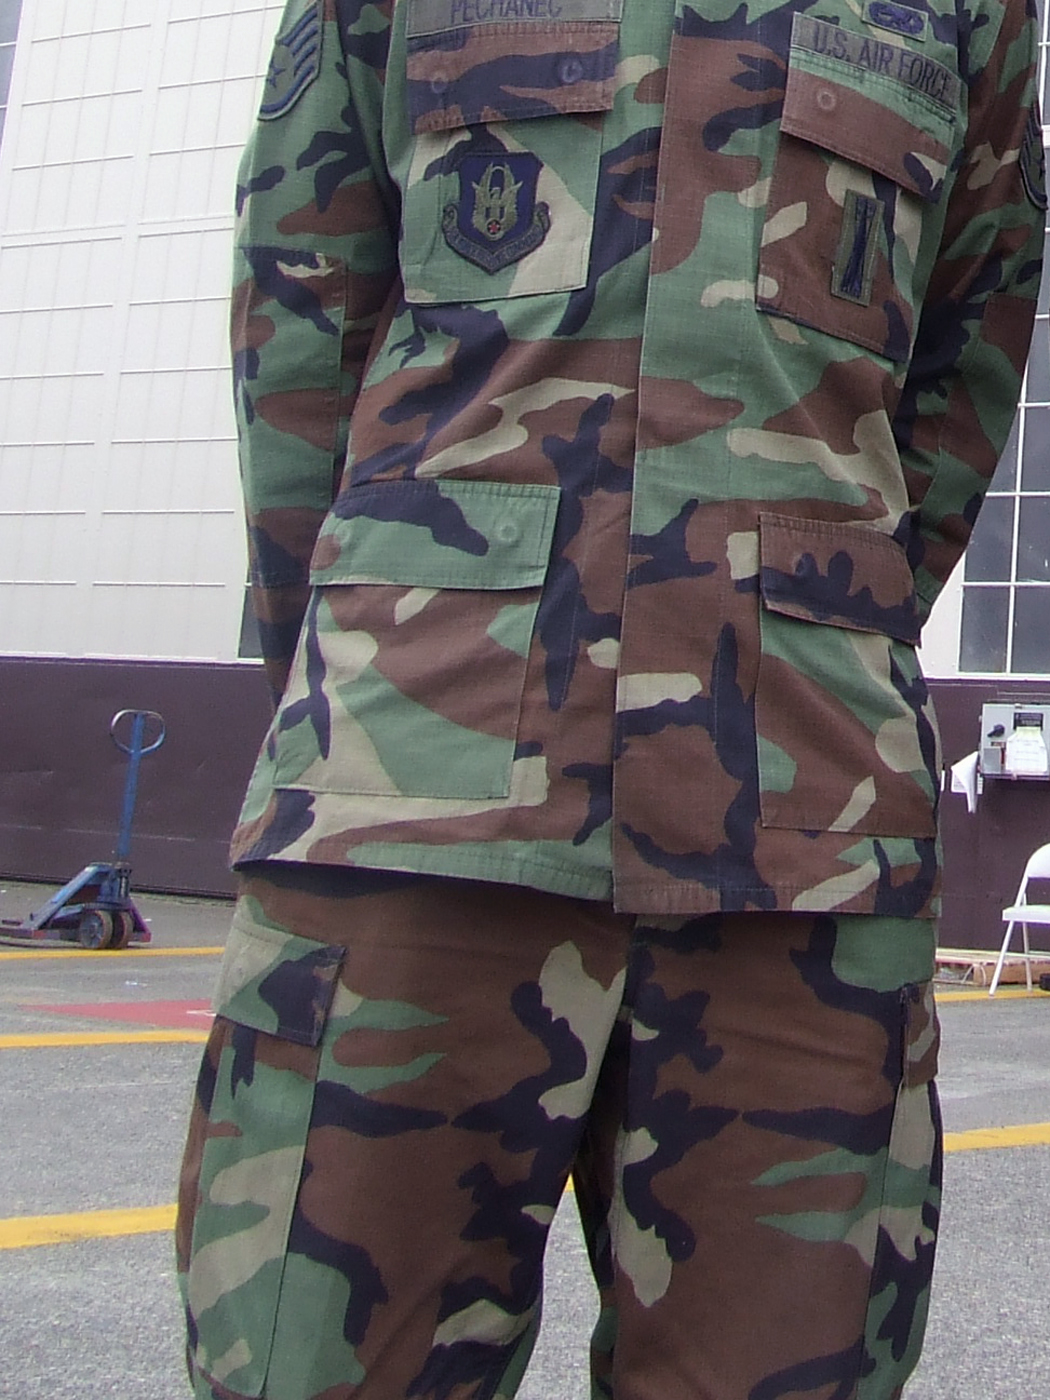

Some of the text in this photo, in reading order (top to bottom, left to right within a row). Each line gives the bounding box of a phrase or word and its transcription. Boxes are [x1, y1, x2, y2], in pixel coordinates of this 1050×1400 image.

[812, 24, 952, 101] U.S. AIR FORCE
